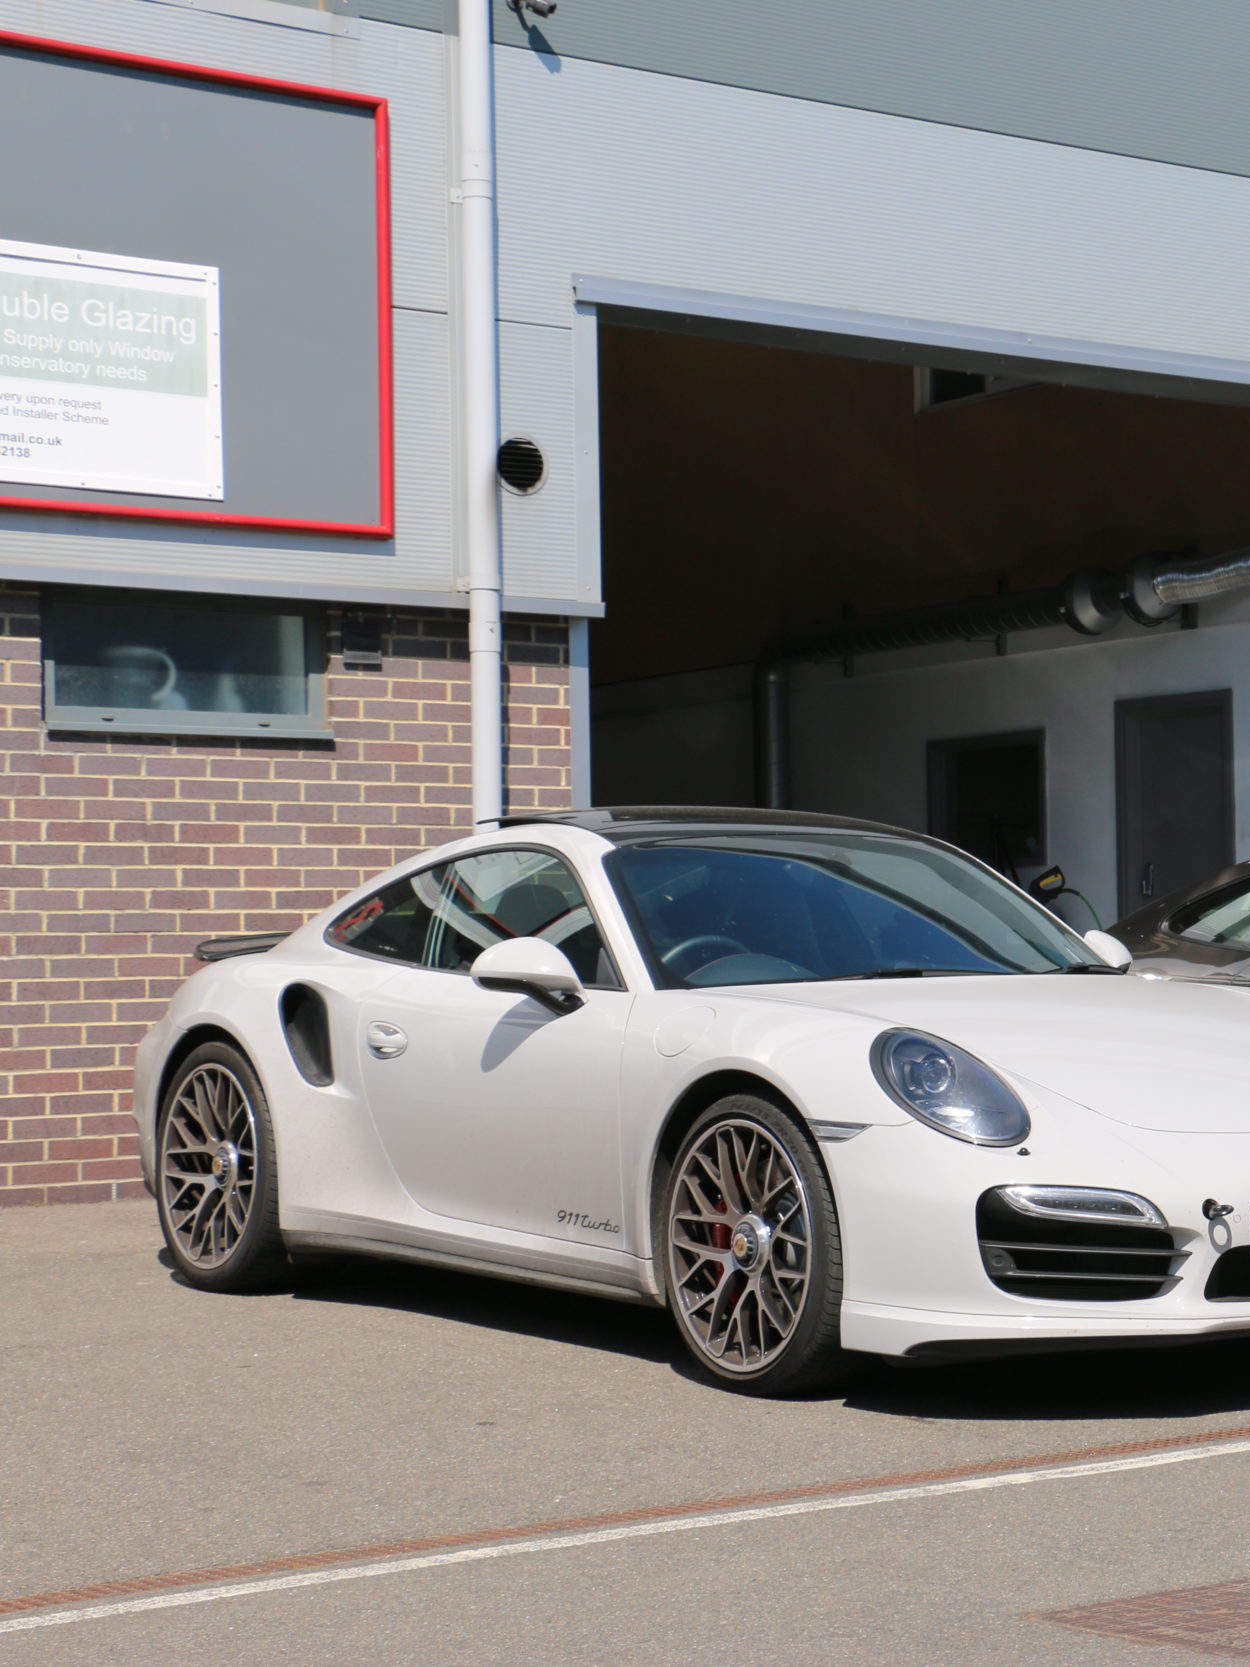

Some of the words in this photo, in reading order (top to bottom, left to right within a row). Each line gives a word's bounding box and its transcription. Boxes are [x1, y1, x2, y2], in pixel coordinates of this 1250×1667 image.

[81, 298, 197, 344] Glazing
[3, 328, 63, 353] Supply
[68, 338, 104, 358] only
[108, 340, 175, 362] Window
[96, 364, 147, 381] needs
[26, 394, 55, 405] upon
[59, 398, 102, 410] request
[13, 406, 58, 420] Installer
[62, 411, 109, 426] Scheme
[0, 446, 31, 458] 2138
